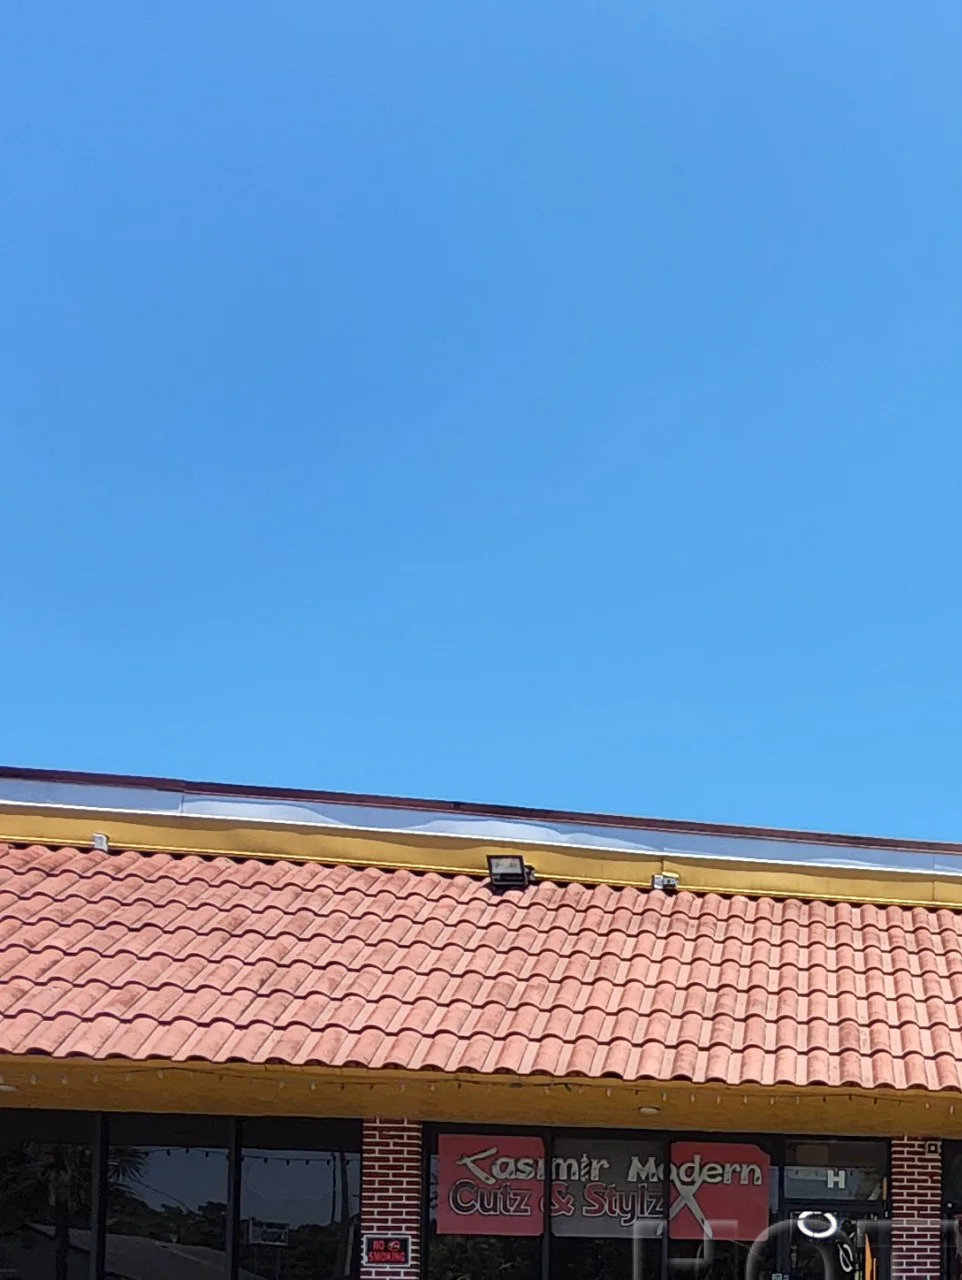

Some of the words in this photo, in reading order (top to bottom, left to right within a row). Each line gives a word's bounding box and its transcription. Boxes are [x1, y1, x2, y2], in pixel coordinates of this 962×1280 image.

[628, 1153, 763, 1186] Modern
[827, 1169, 846, 1189] H
[449, 1179, 532, 1217] Cutz
[540, 1181, 575, 1217] &
[582, 1182, 664, 1227] Stylz
